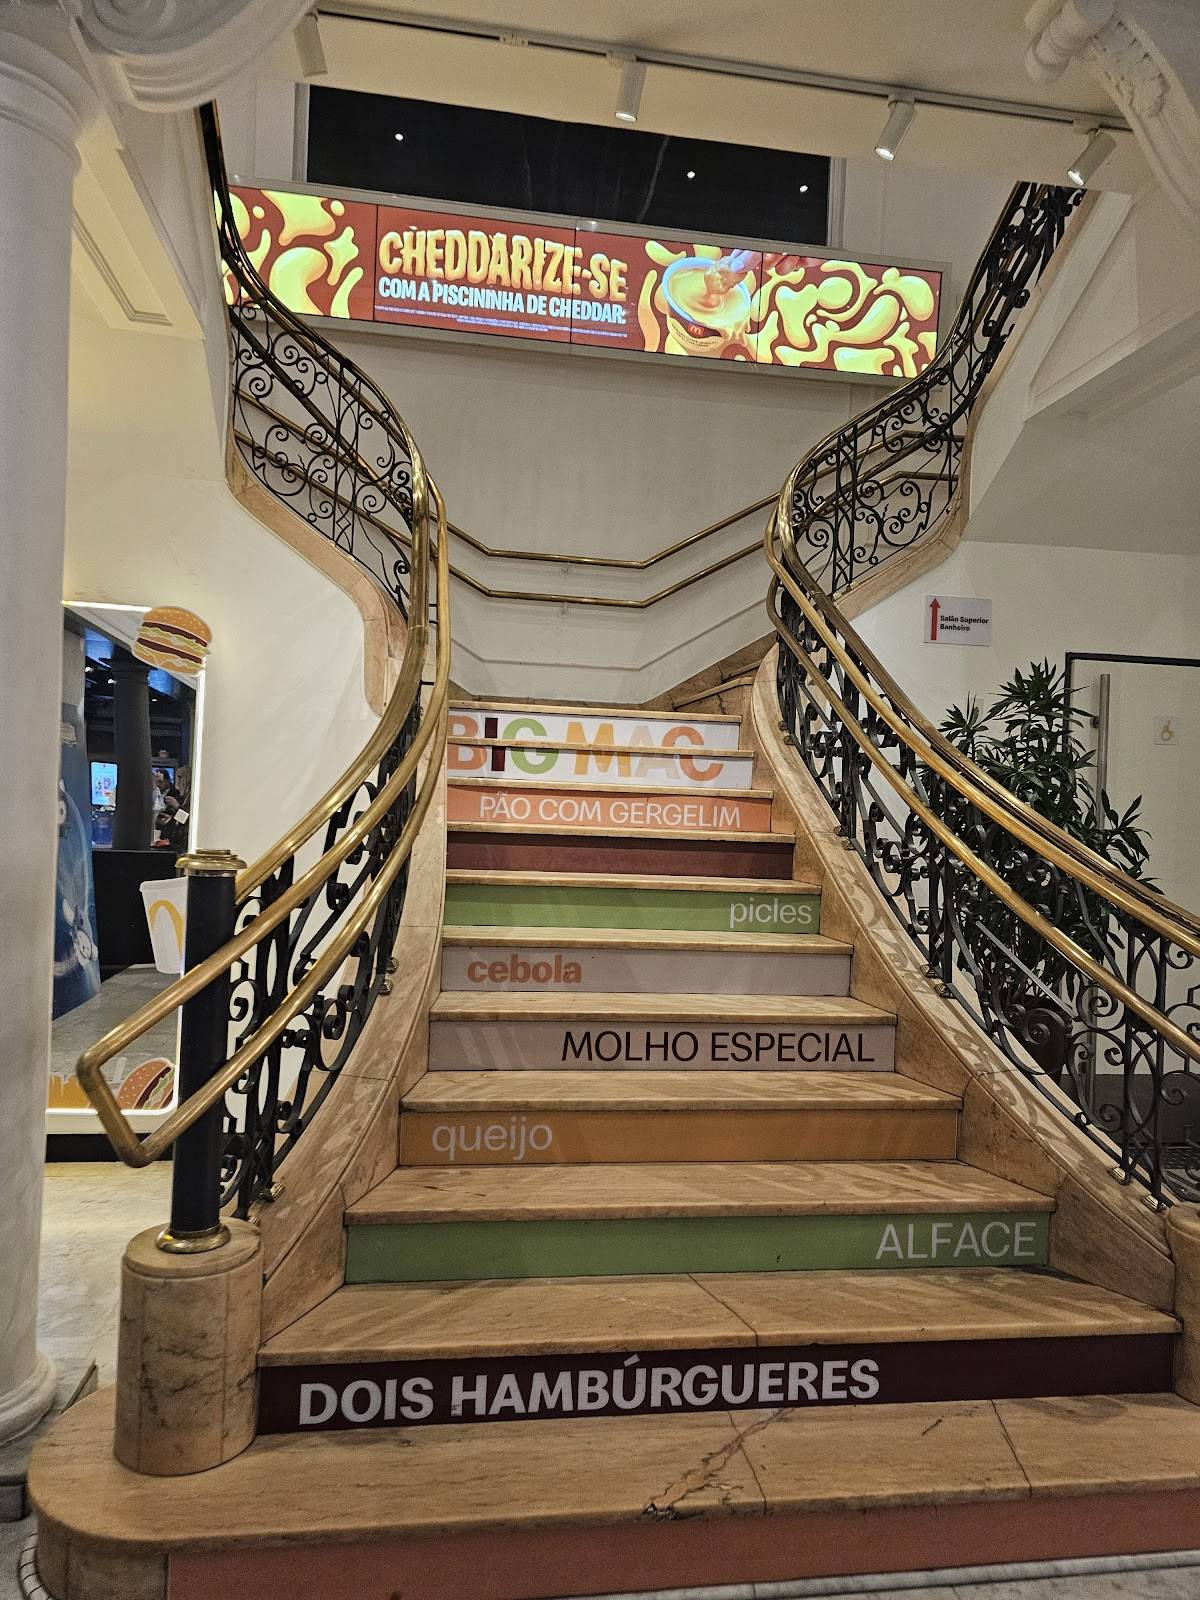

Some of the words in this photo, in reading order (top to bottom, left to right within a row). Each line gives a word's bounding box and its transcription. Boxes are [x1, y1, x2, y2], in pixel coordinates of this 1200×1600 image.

[379, 229, 628, 302] CHEDDARIZE-SE
[378, 277, 416, 300] COM
[417, 282, 431, 302] A
[432, 282, 524, 314] PISCININHA
[526, 294, 547, 315] DE
[549, 297, 626, 325] CHEDDAR.
[939, 623, 971, 631] Banheiro
[960, 616, 989, 625] Superior
[448, 714, 560, 774] BIG
[566, 720, 724, 782] MAC
[480, 791, 531, 820] PÃO
[538, 798, 601, 823] COM
[609, 801, 741, 829] GERGELIM
[729, 898, 812, 929] picles
[466, 953, 582, 984] cebola
[562, 1031, 699, 1062] MOLHO
[711, 1032, 875, 1063] ESPECIAL
[431, 1116, 554, 1161] queijo
[875, 1221, 1036, 1262] ALFACE
[298, 1376, 435, 1425] DOIS
[450, 1354, 881, 1417] HAMBÚRGUERES
